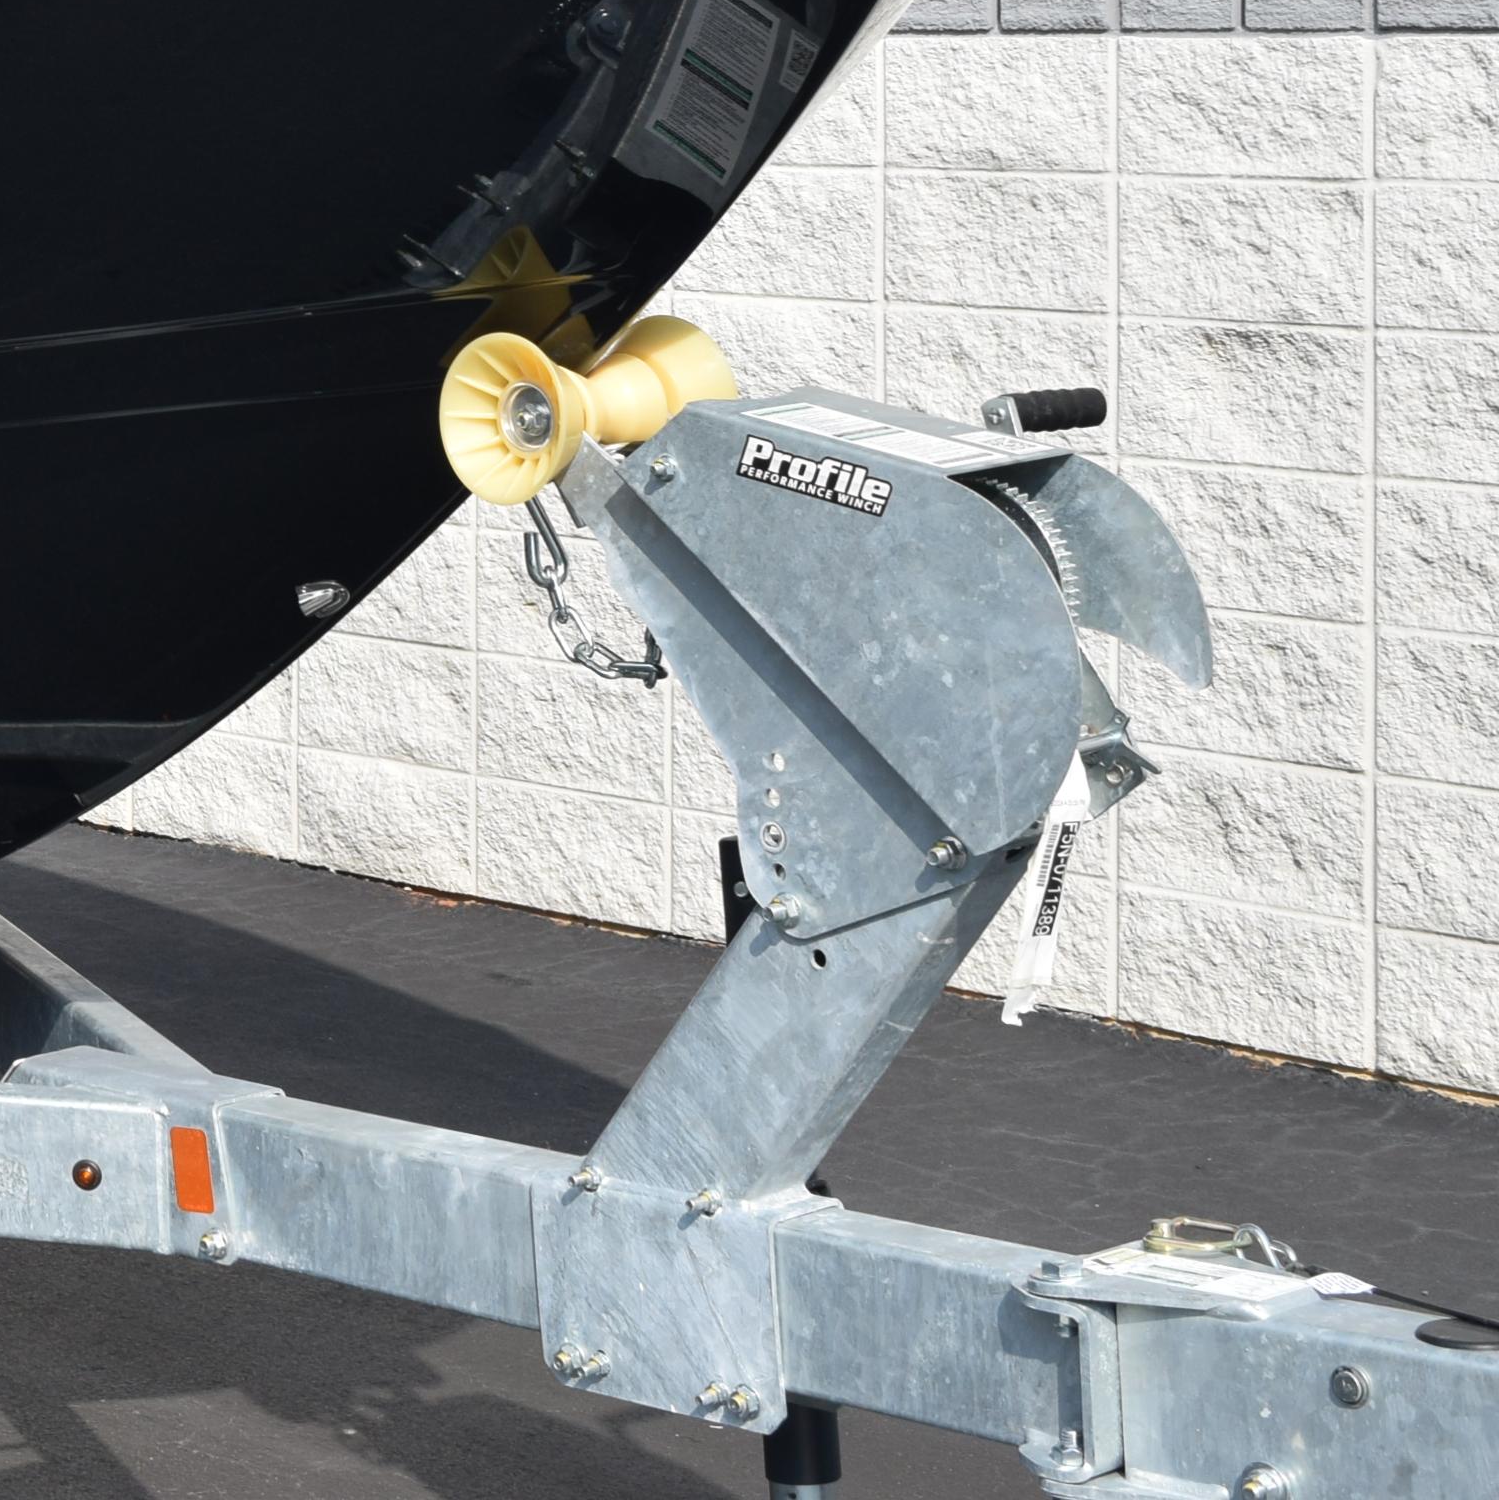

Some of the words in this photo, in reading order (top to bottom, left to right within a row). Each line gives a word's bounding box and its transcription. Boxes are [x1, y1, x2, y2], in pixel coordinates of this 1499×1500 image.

[739, 464, 834, 500] PERFORMANCE
[837, 492, 884, 515] WINCH
[741, 436, 892, 506] Profile
